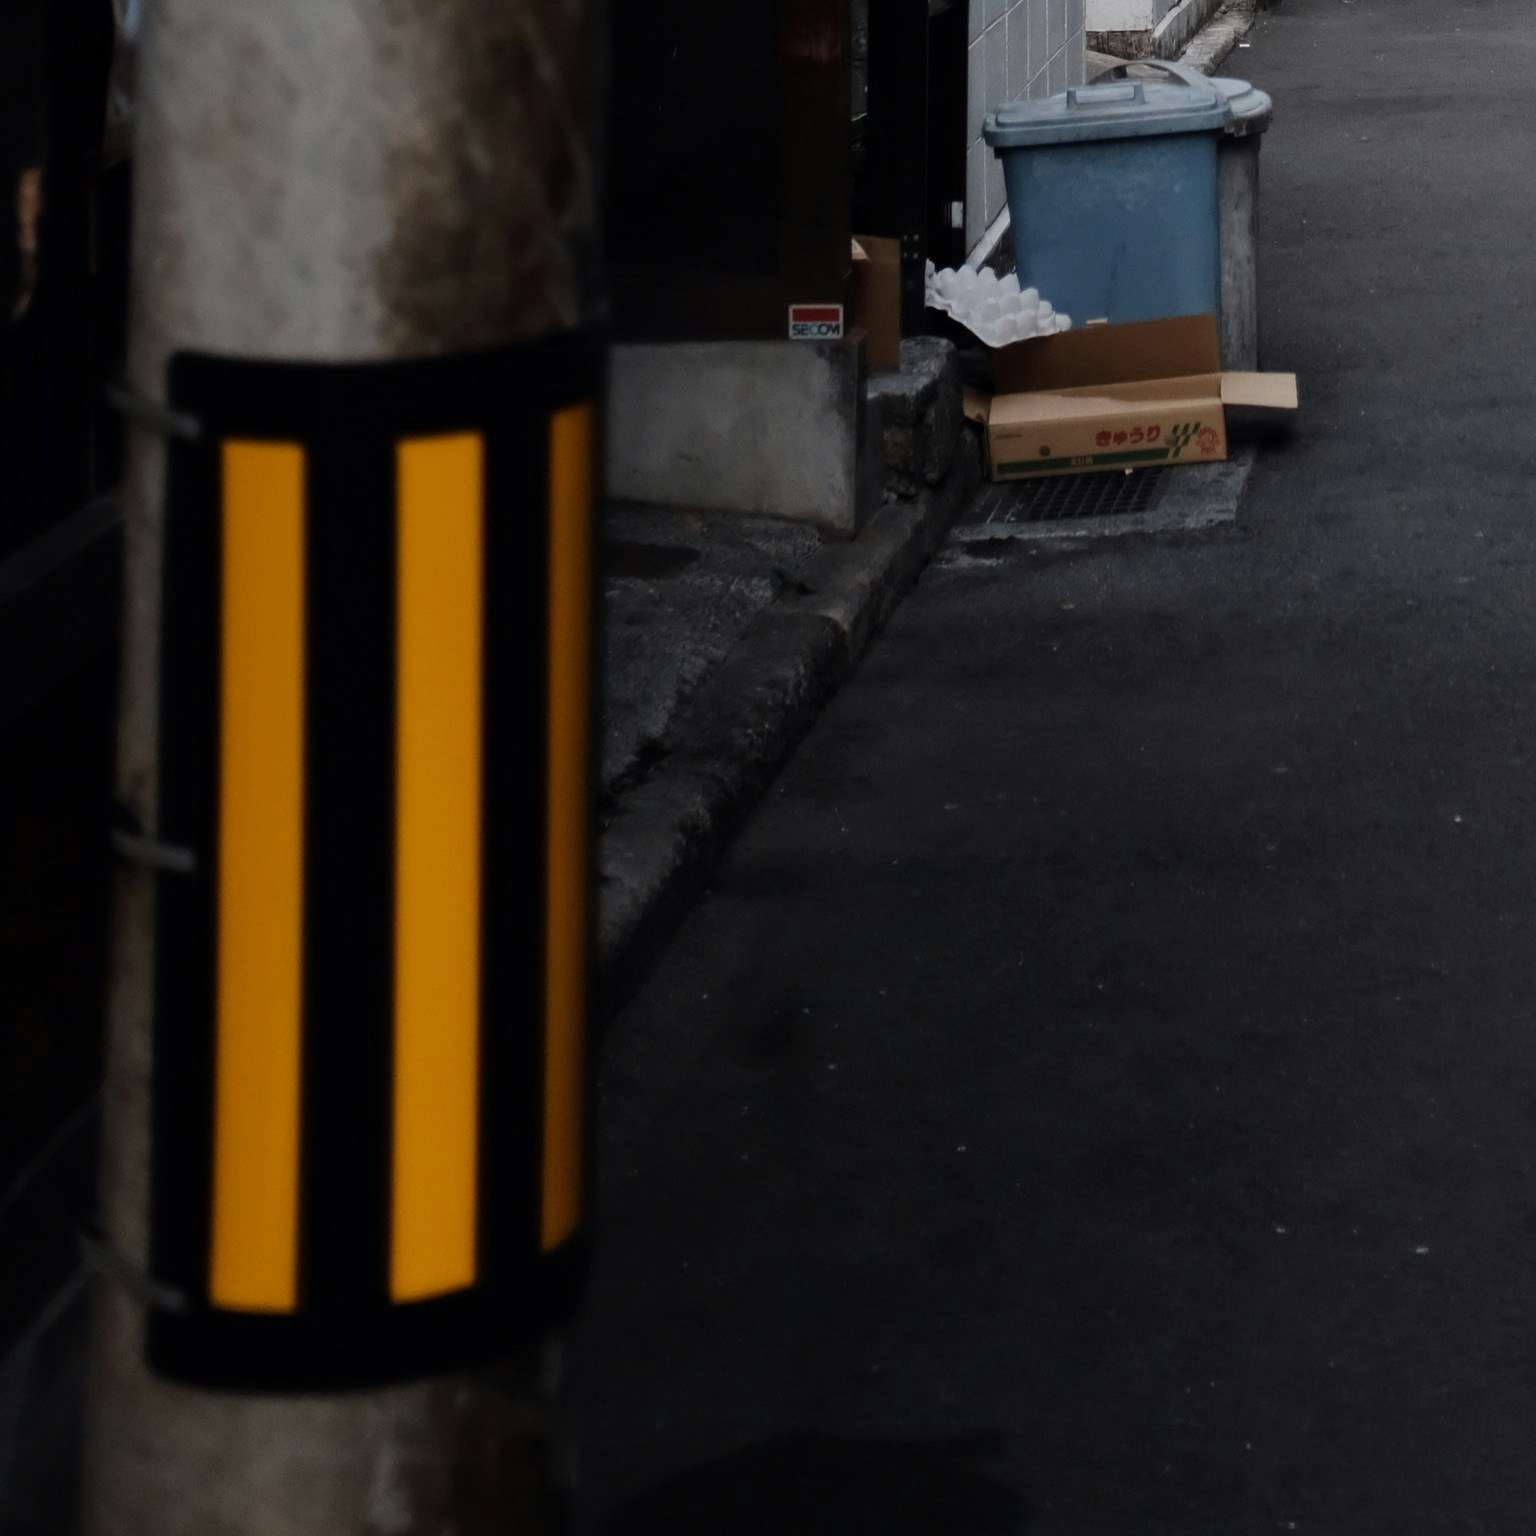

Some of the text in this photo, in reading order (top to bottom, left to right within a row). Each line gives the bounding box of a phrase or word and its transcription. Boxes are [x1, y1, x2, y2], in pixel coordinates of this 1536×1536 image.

[792, 323, 840, 336] SECOM
[1095, 424, 1161, 448] きゅうり
